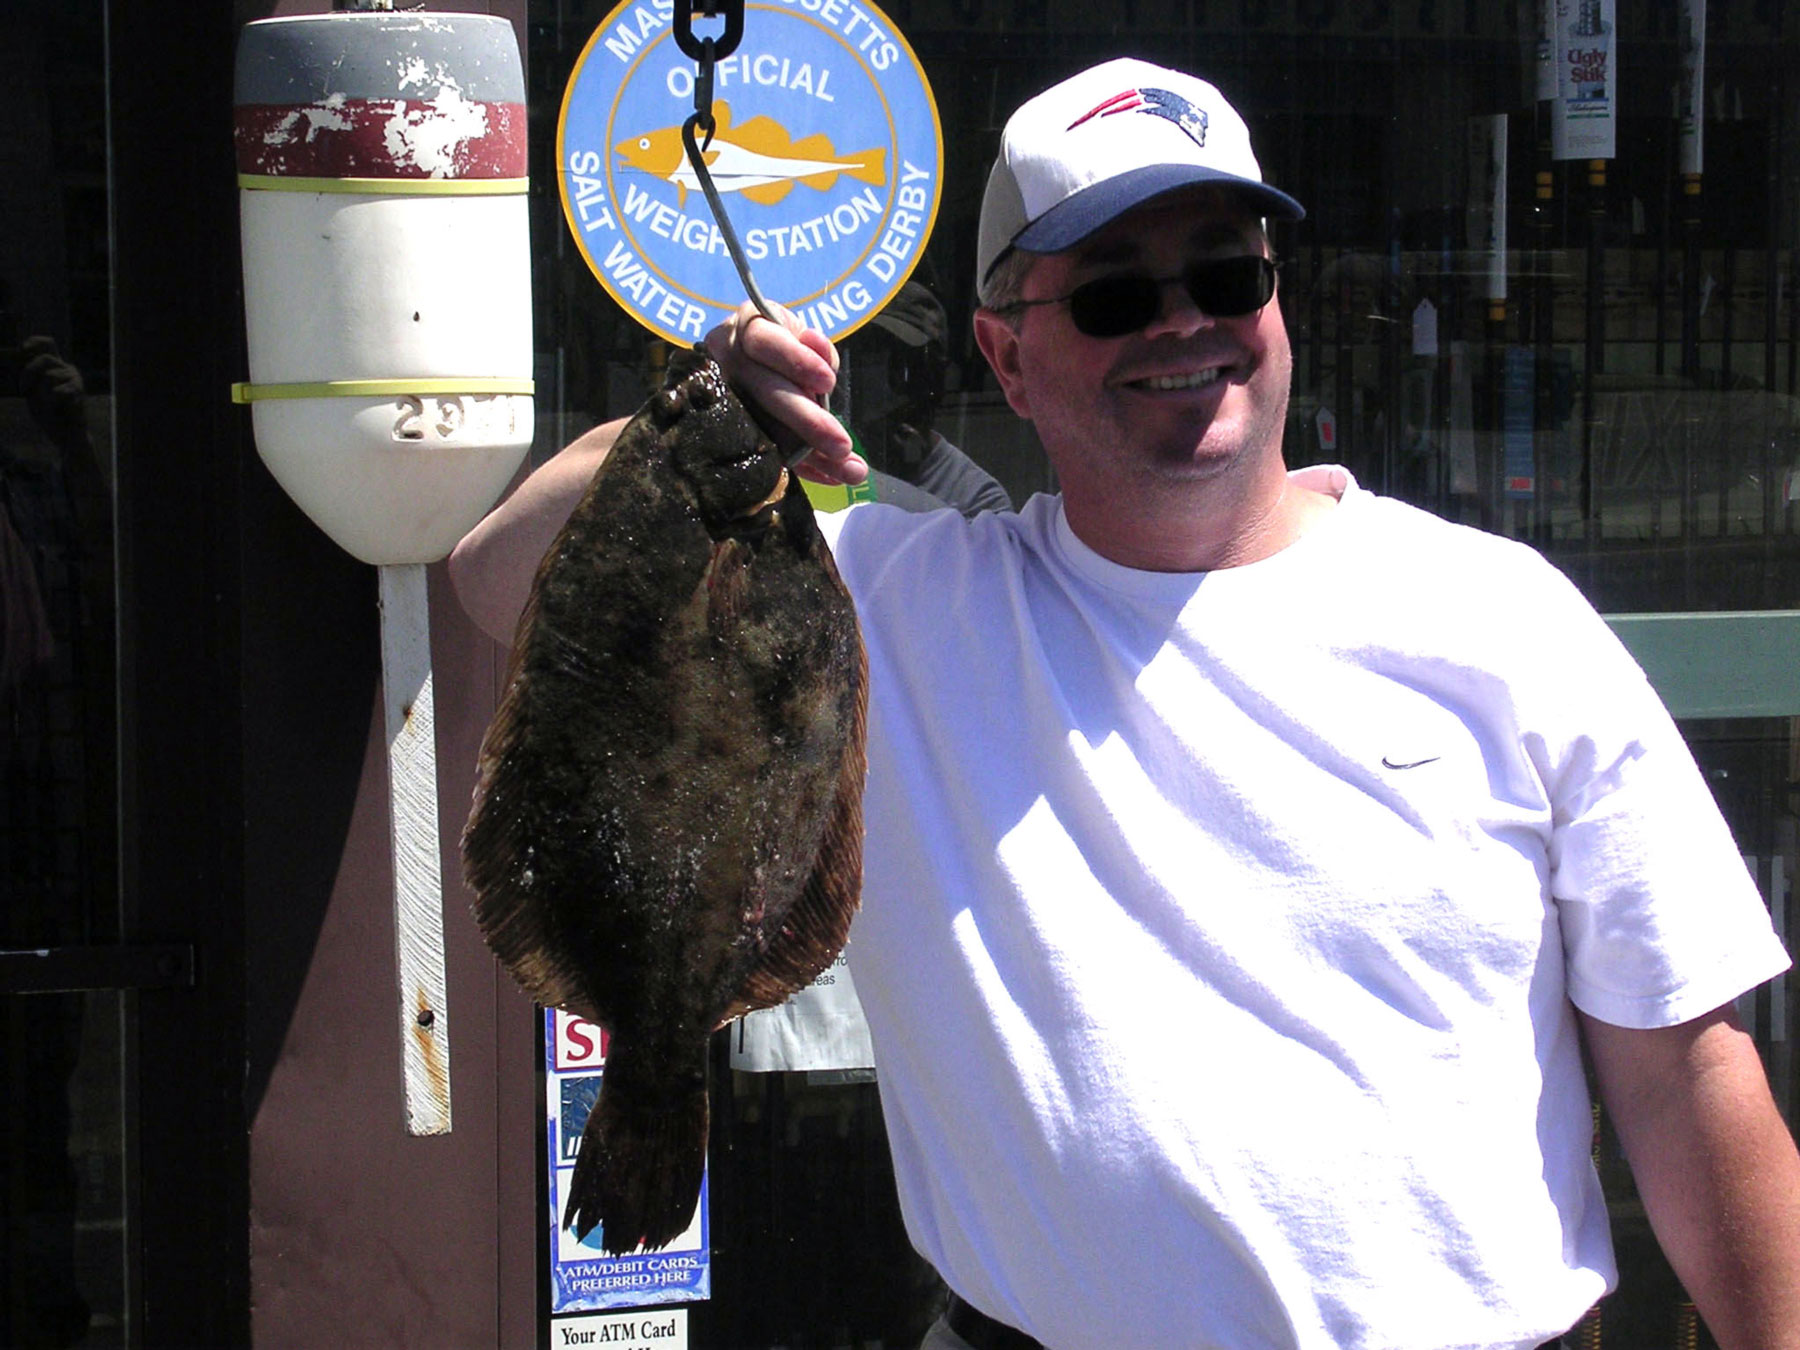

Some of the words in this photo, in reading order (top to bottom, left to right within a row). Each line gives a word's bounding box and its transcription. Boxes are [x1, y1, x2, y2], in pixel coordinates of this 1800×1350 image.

[1567, 48, 1607, 68] Ugly
[666, 53, 834, 102] OFICIAL
[746, 187, 883, 260] STATION
[570, 151, 615, 232] SALT
[604, 240, 706, 338] WATER
[866, 160, 930, 283] DERBY
[566, 1261, 645, 1278] ATM/DEBIT
[648, 1256, 698, 1271] CARDS
[572, 1274, 651, 1291] PREFERRED
[654, 1270, 692, 1285] HERE
[561, 1327, 596, 1345] Your
[600, 1322, 636, 1343] ATM
[641, 1318, 676, 1339] Card
